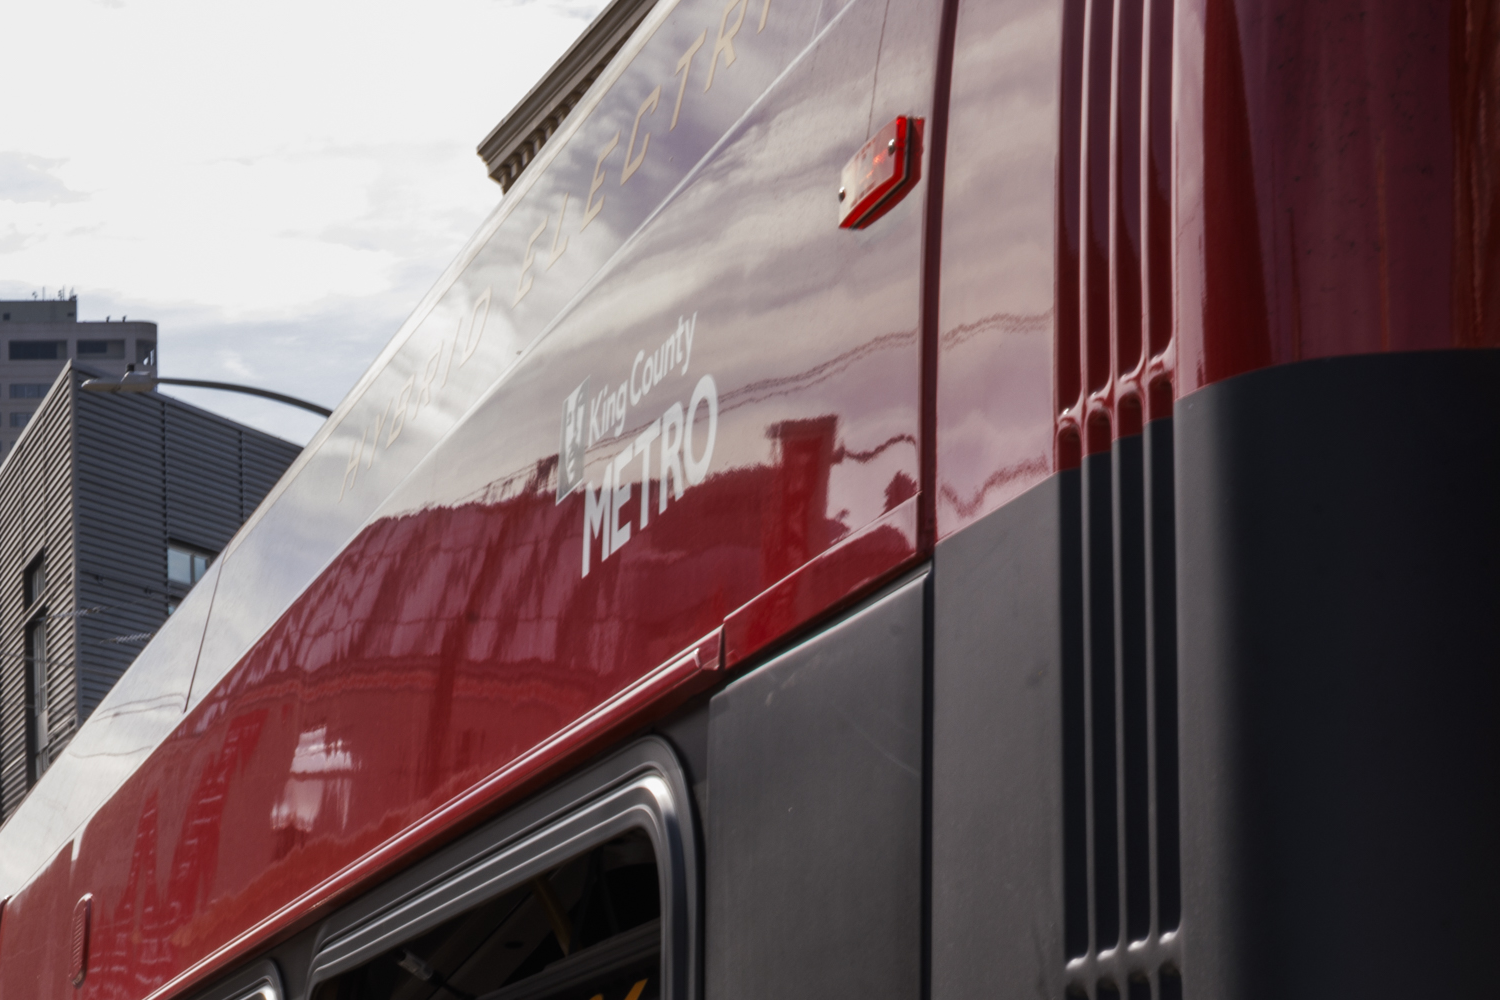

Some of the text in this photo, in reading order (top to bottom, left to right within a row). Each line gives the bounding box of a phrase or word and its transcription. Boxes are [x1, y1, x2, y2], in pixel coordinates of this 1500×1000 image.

[588, 310, 699, 449] King County
[581, 373, 719, 580] METRO
